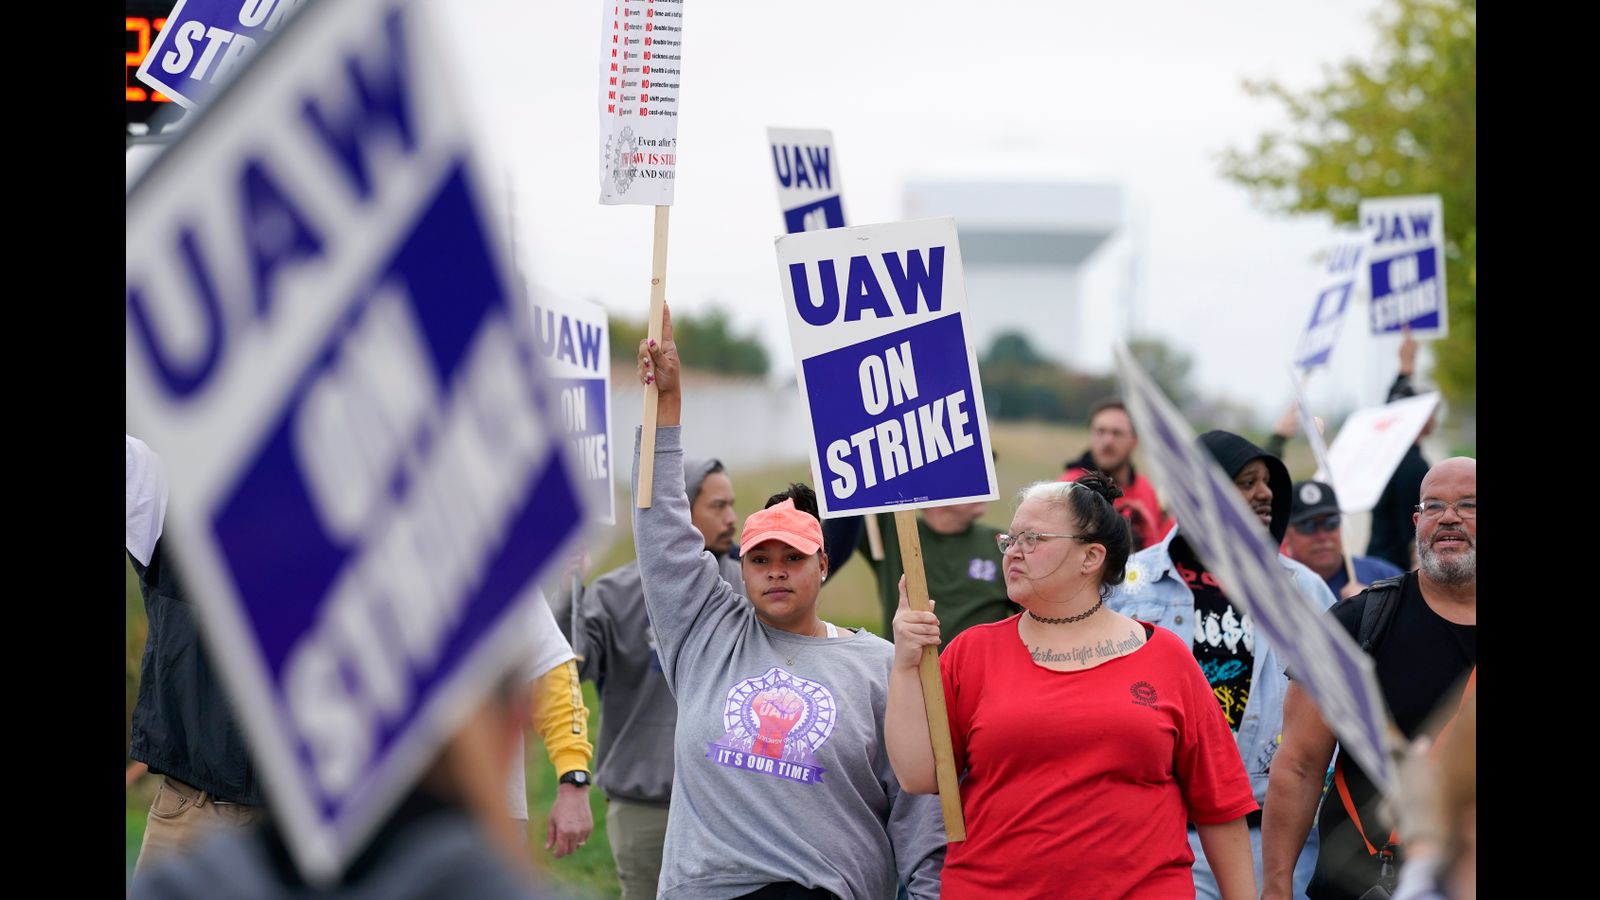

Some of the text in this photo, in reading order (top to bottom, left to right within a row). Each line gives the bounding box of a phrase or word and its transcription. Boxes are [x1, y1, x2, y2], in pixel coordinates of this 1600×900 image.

[162, 20, 256, 85] STR
[638, 136, 656, 146] Even
[648, 153, 659, 165] IS
[639, 169, 657, 178] AND
[772, 145, 831, 190] UAW
[789, 246, 945, 326] UAW
[534, 305, 602, 372] UAW
[858, 341, 918, 416] ON
[561, 386, 587, 433] ON
[826, 390, 974, 500] STRIKE
[718, 749, 810, 781] IT'S OUR TIME
